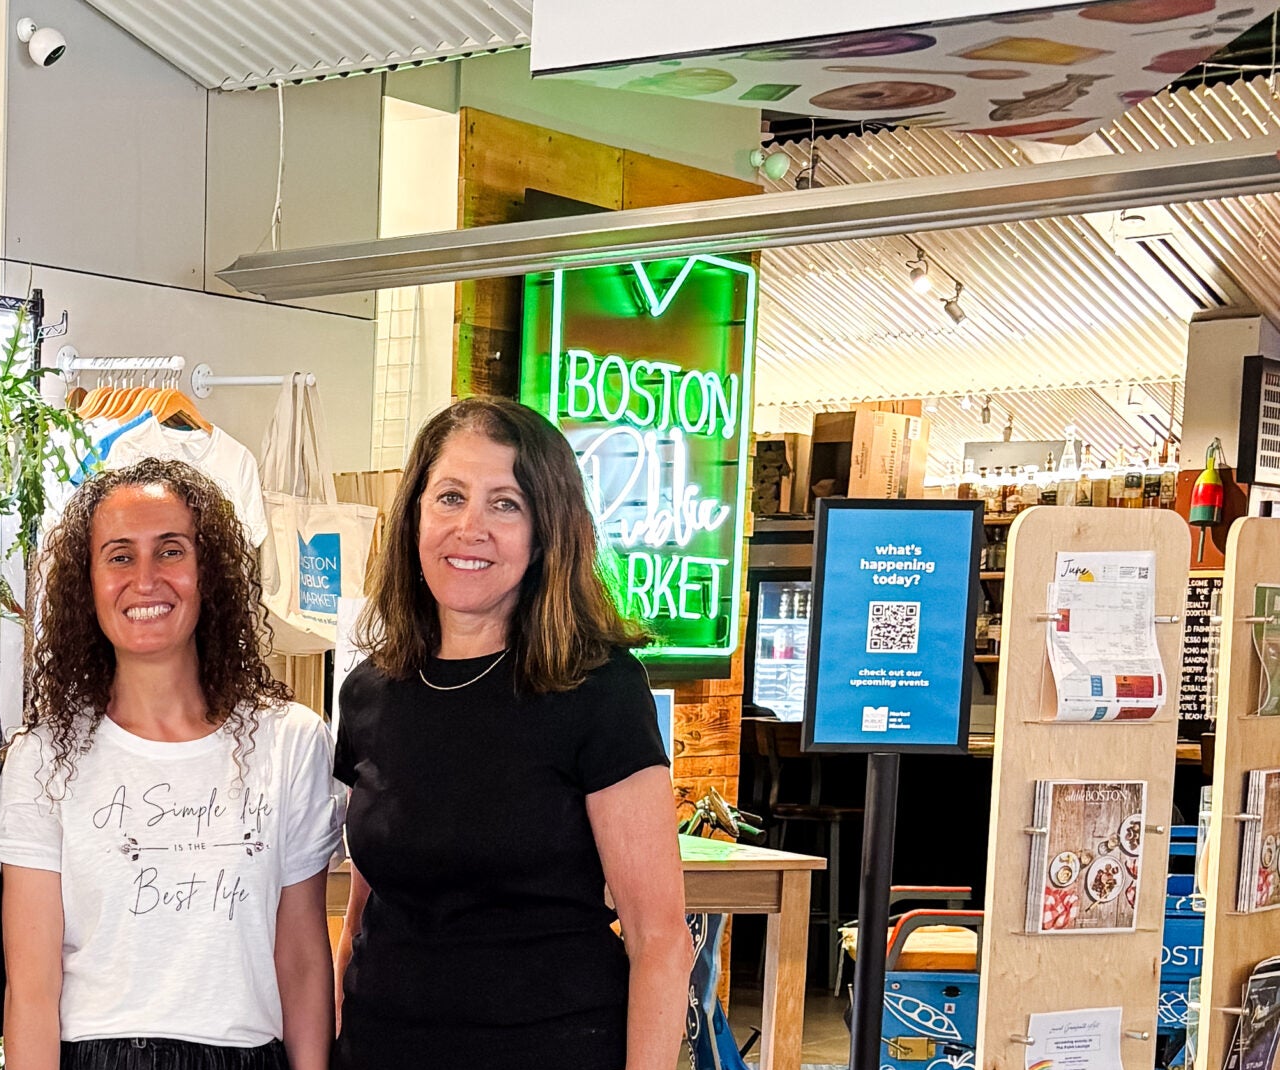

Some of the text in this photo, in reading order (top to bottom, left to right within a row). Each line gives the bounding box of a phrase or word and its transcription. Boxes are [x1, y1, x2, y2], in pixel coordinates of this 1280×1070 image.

[567, 350, 739, 439] BOSTON
[579, 426, 729, 546] Public
[875, 544, 922, 556] what's
[303, 556, 337, 570] STON
[860, 558, 935, 573] happening
[1061, 559, 1089, 577] June
[626, 552, 729, 620] RKET
[872, 573, 921, 588] today?
[858, 668, 887, 676] check
[888, 669, 905, 677] out
[849, 677, 930, 688] upcoming events
[93, 783, 273, 837] A Simple life
[174, 843, 206, 852] IS THE
[129, 867, 250, 920] Best life
